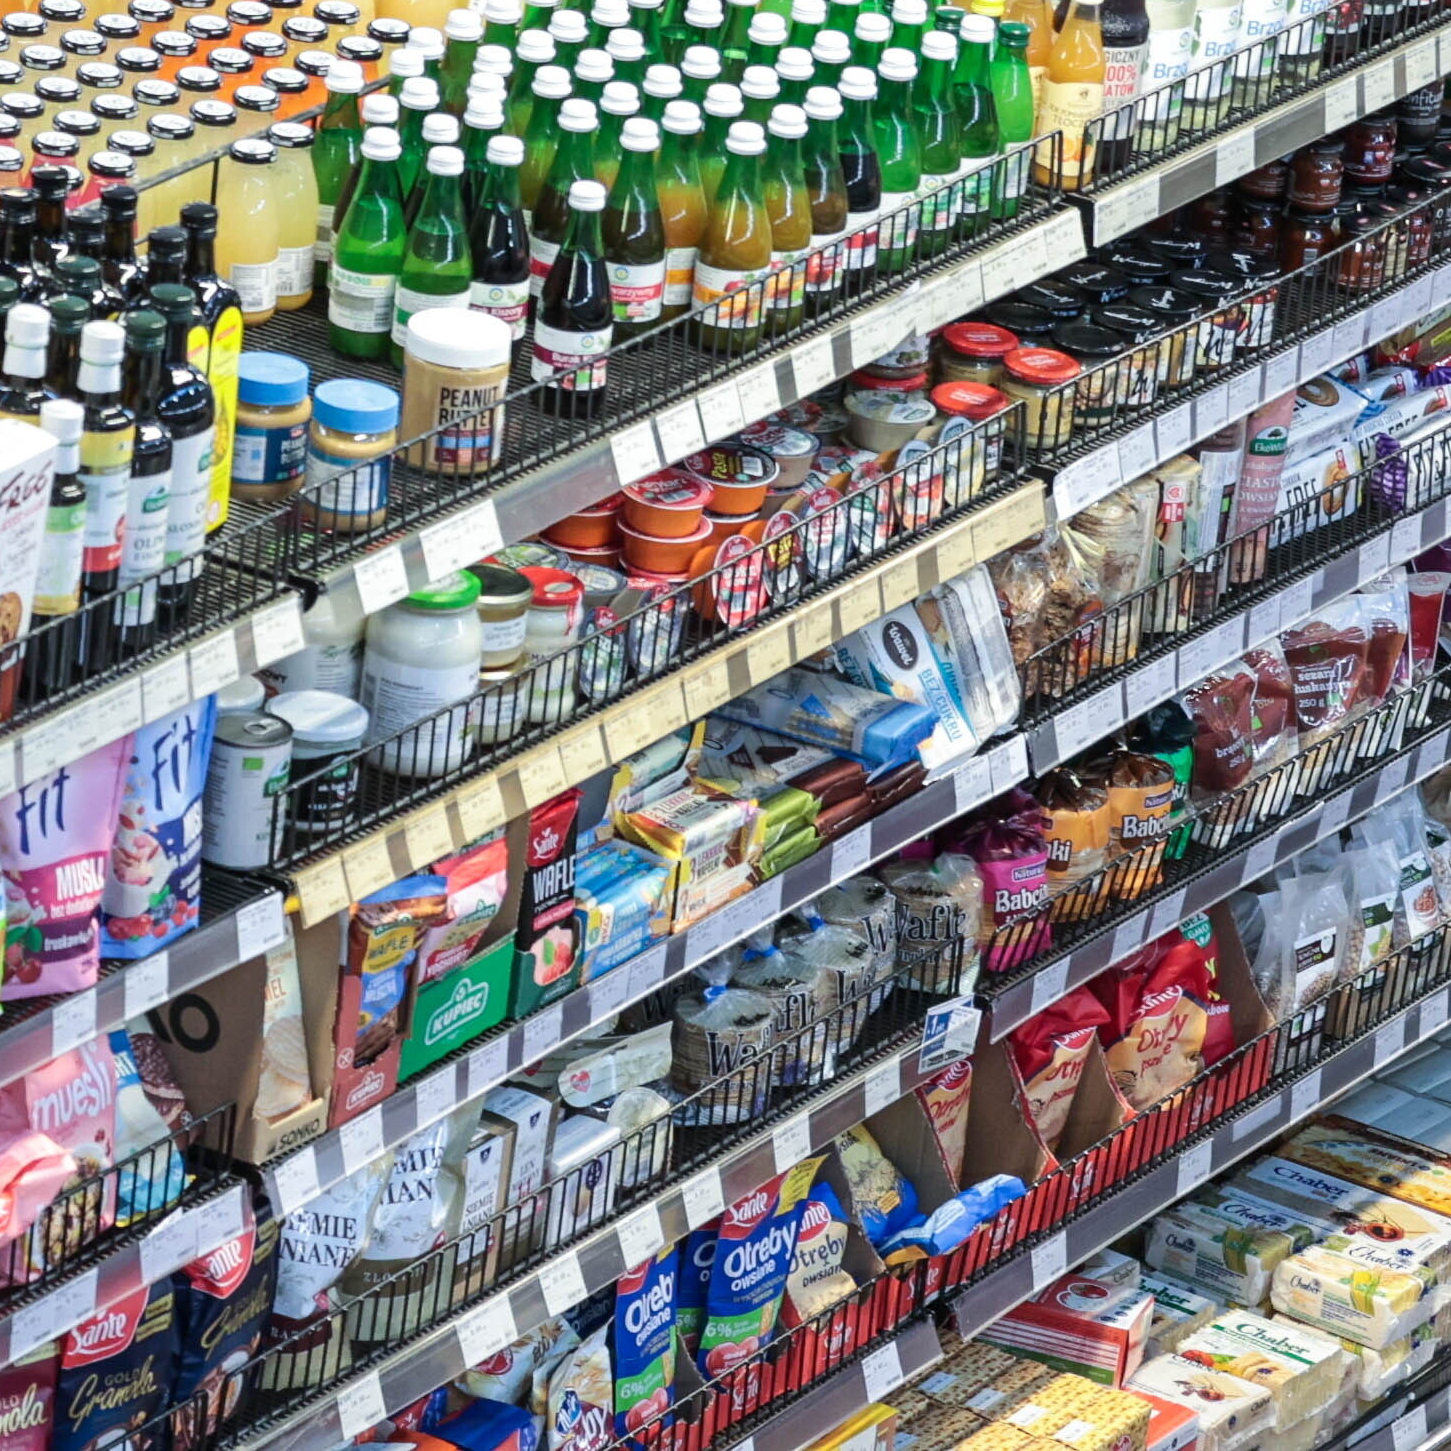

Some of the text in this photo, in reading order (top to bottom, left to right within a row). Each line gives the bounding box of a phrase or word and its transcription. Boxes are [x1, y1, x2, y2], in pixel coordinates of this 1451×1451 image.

[440, 385, 498, 409] PEANUT
[151, 719, 202, 816] Fit
[15, 768, 71, 852] Fit
[532, 858, 577, 897] WAFLE
[430, 989, 485, 1037] KUPIEC
[278, 1117, 321, 1149] SONKO
[1274, 1164, 1349, 1200] Chaber
[207, 1239, 242, 1279] ante
[730, 1258, 777, 1292] owsiane
[69, 1307, 127, 1358] Sante
[1235, 1320, 1311, 1356] Chaber
